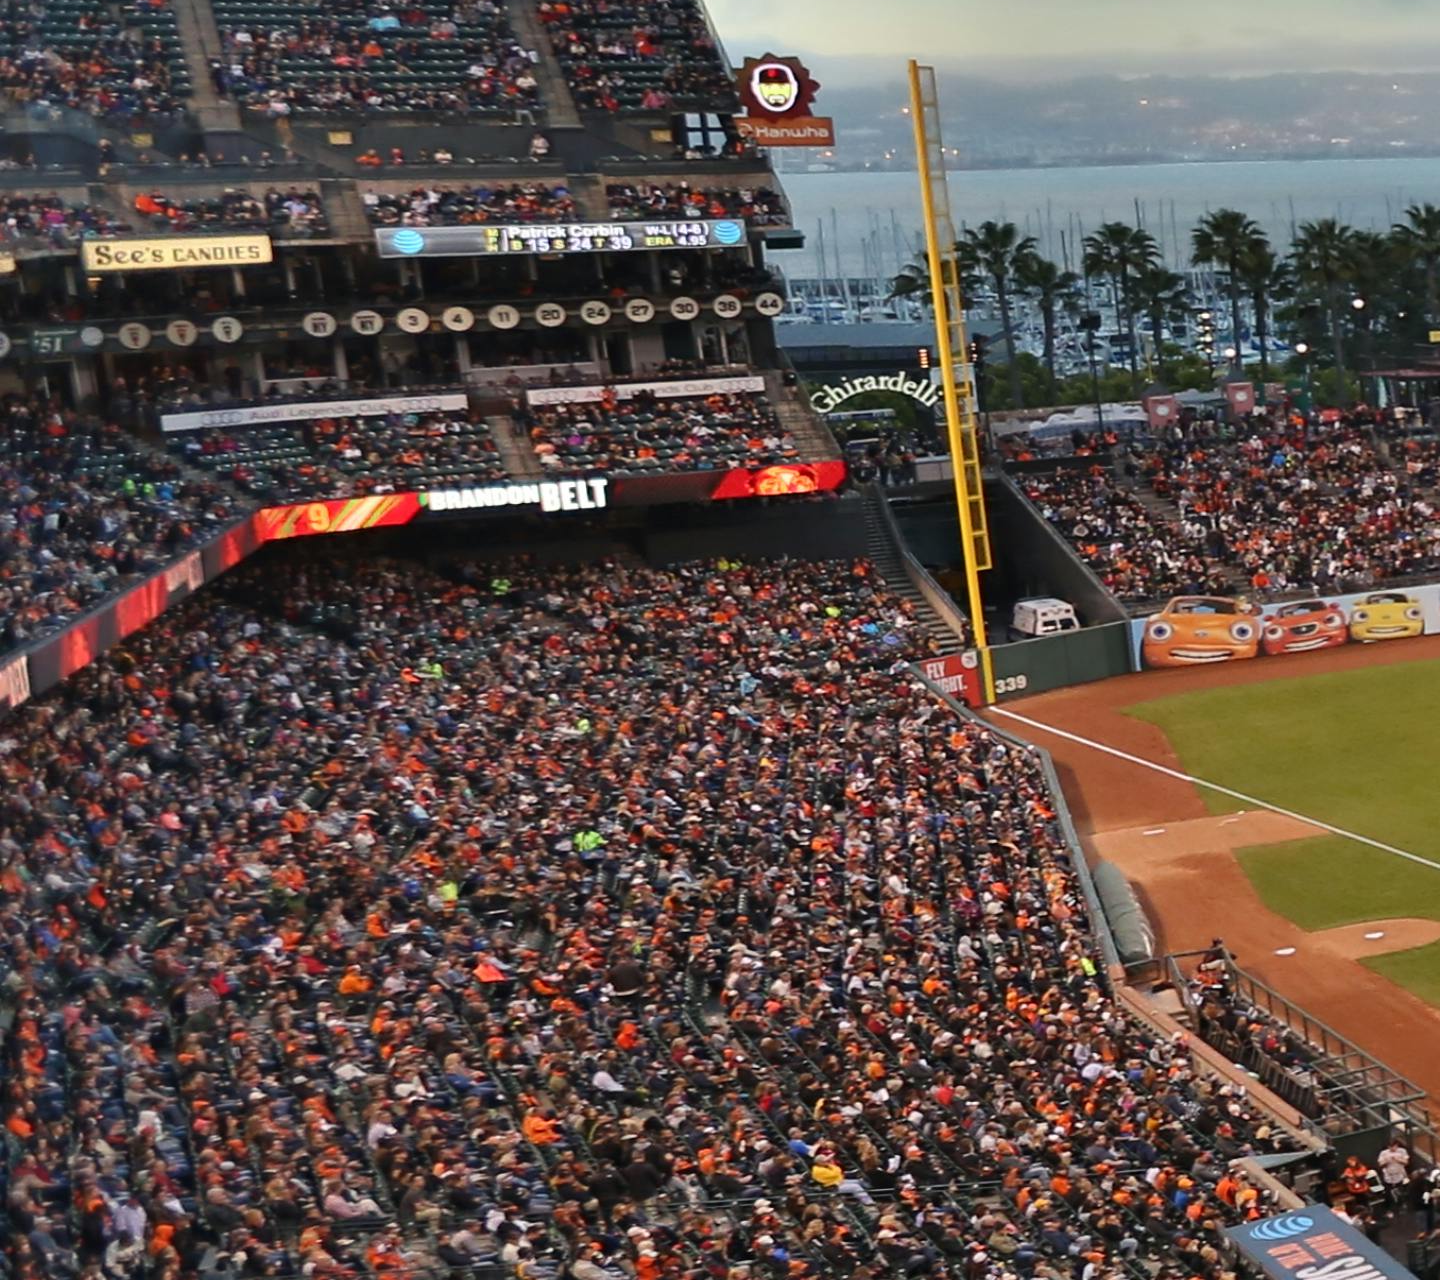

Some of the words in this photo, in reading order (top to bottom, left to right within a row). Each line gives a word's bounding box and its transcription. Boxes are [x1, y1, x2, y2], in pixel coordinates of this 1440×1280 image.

[755, 126, 829, 138] Hanwha
[508, 225, 566, 239] Patrick
[569, 223, 624, 237] Corbin
[528, 237, 549, 252] 15
[570, 237, 592, 251] 24
[610, 236, 632, 250] 39
[645, 235, 673, 247] ERA
[677, 234, 706, 247] 4.95
[95, 245, 164, 266] See's
[173, 245, 260, 262] CANDIES
[632, 305, 650, 316] 27
[675, 302, 694, 314] 30
[760, 299, 778, 309] 44
[453, 314, 463, 325] 4
[497, 311, 510, 322] 11
[541, 309, 560, 321] 20
[586, 308, 606, 319] 24
[408, 315, 419, 327] 3
[809, 370, 944, 413] Ghirardelli
[251, 409, 283, 420] Audi
[288, 405, 352, 418] Legends
[359, 402, 391, 412] Club
[428, 484, 539, 511] BRANDON
[539, 478, 609, 512] BELT
[308, 503, 330, 531] 9
[926, 661, 945, 679] FLY
[995, 674, 1028, 693] 339
